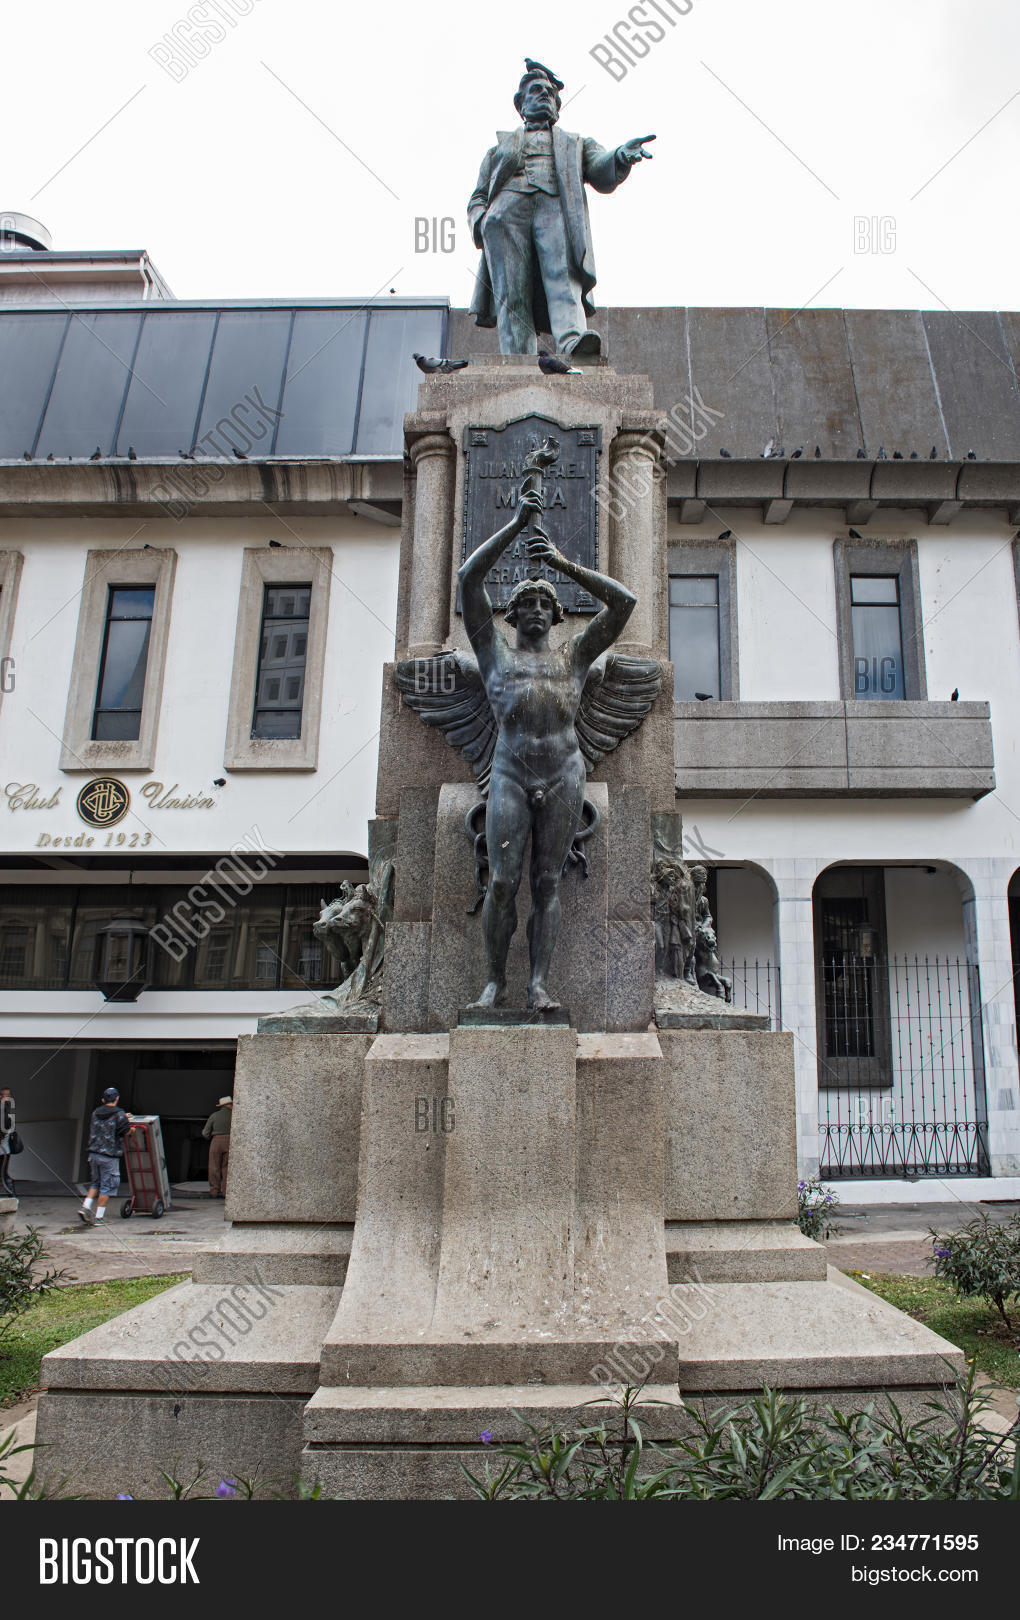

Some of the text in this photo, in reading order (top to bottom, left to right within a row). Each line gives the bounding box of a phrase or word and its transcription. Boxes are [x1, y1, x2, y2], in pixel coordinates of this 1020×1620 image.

[480, 461, 521, 478] JUAN
[5, 781, 216, 813] Club Unión
[34, 832, 152, 847] Desde 1923
